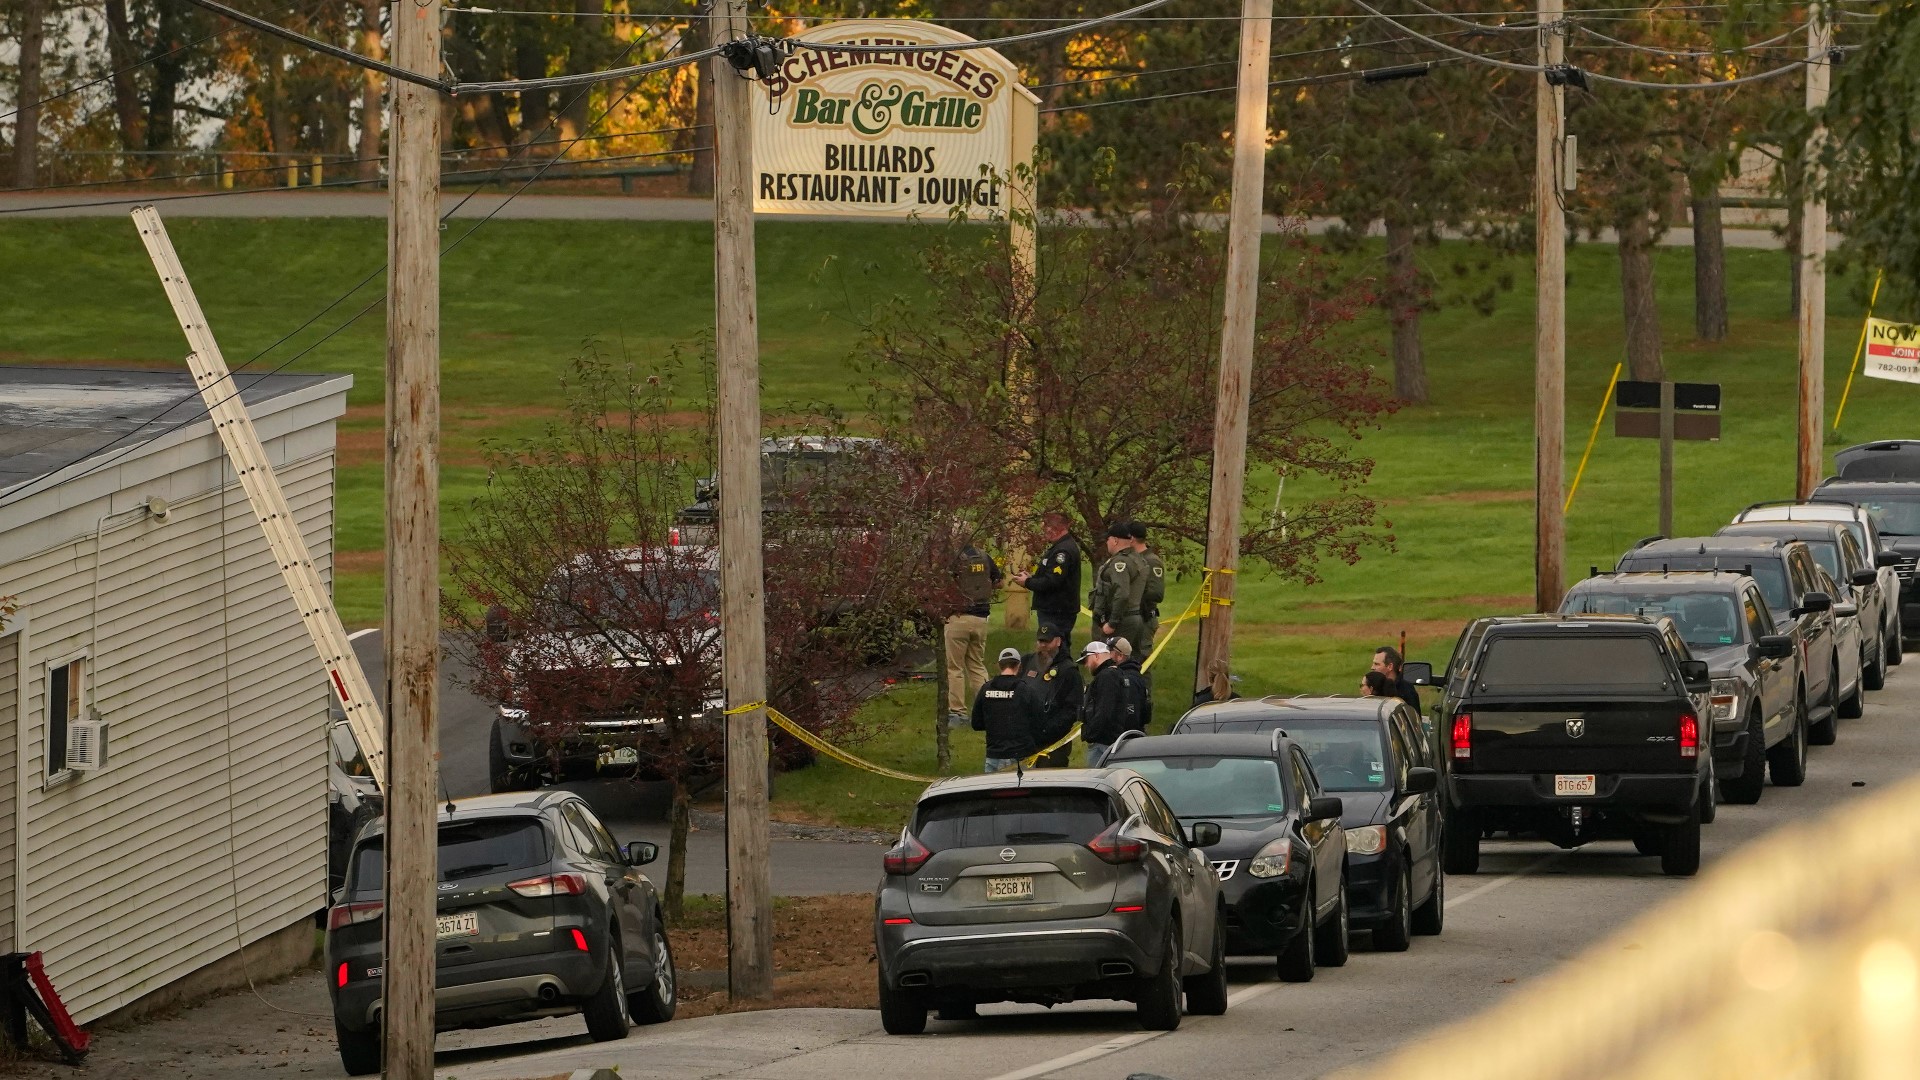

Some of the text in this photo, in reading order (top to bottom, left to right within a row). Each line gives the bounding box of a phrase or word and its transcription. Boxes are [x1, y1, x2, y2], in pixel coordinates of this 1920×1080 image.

[762, 38, 999, 99] SCHEMENGEES
[792, 83, 982, 135] Bar & Grille
[825, 143, 935, 174] BILLIARDS
[760, 172, 1000, 207] RESTAURANT LOUNGE
[1873, 325, 1917, 341] NOW
[1891, 348, 1914, 357] JOIN
[971, 564, 984, 572] FBI
[985, 690, 1015, 699] SHERIFF
[1577, 781, 1592, 790] 657
[995, 881, 1032, 895] 5268 XK
[439, 918, 474, 933] 3674 ZT
